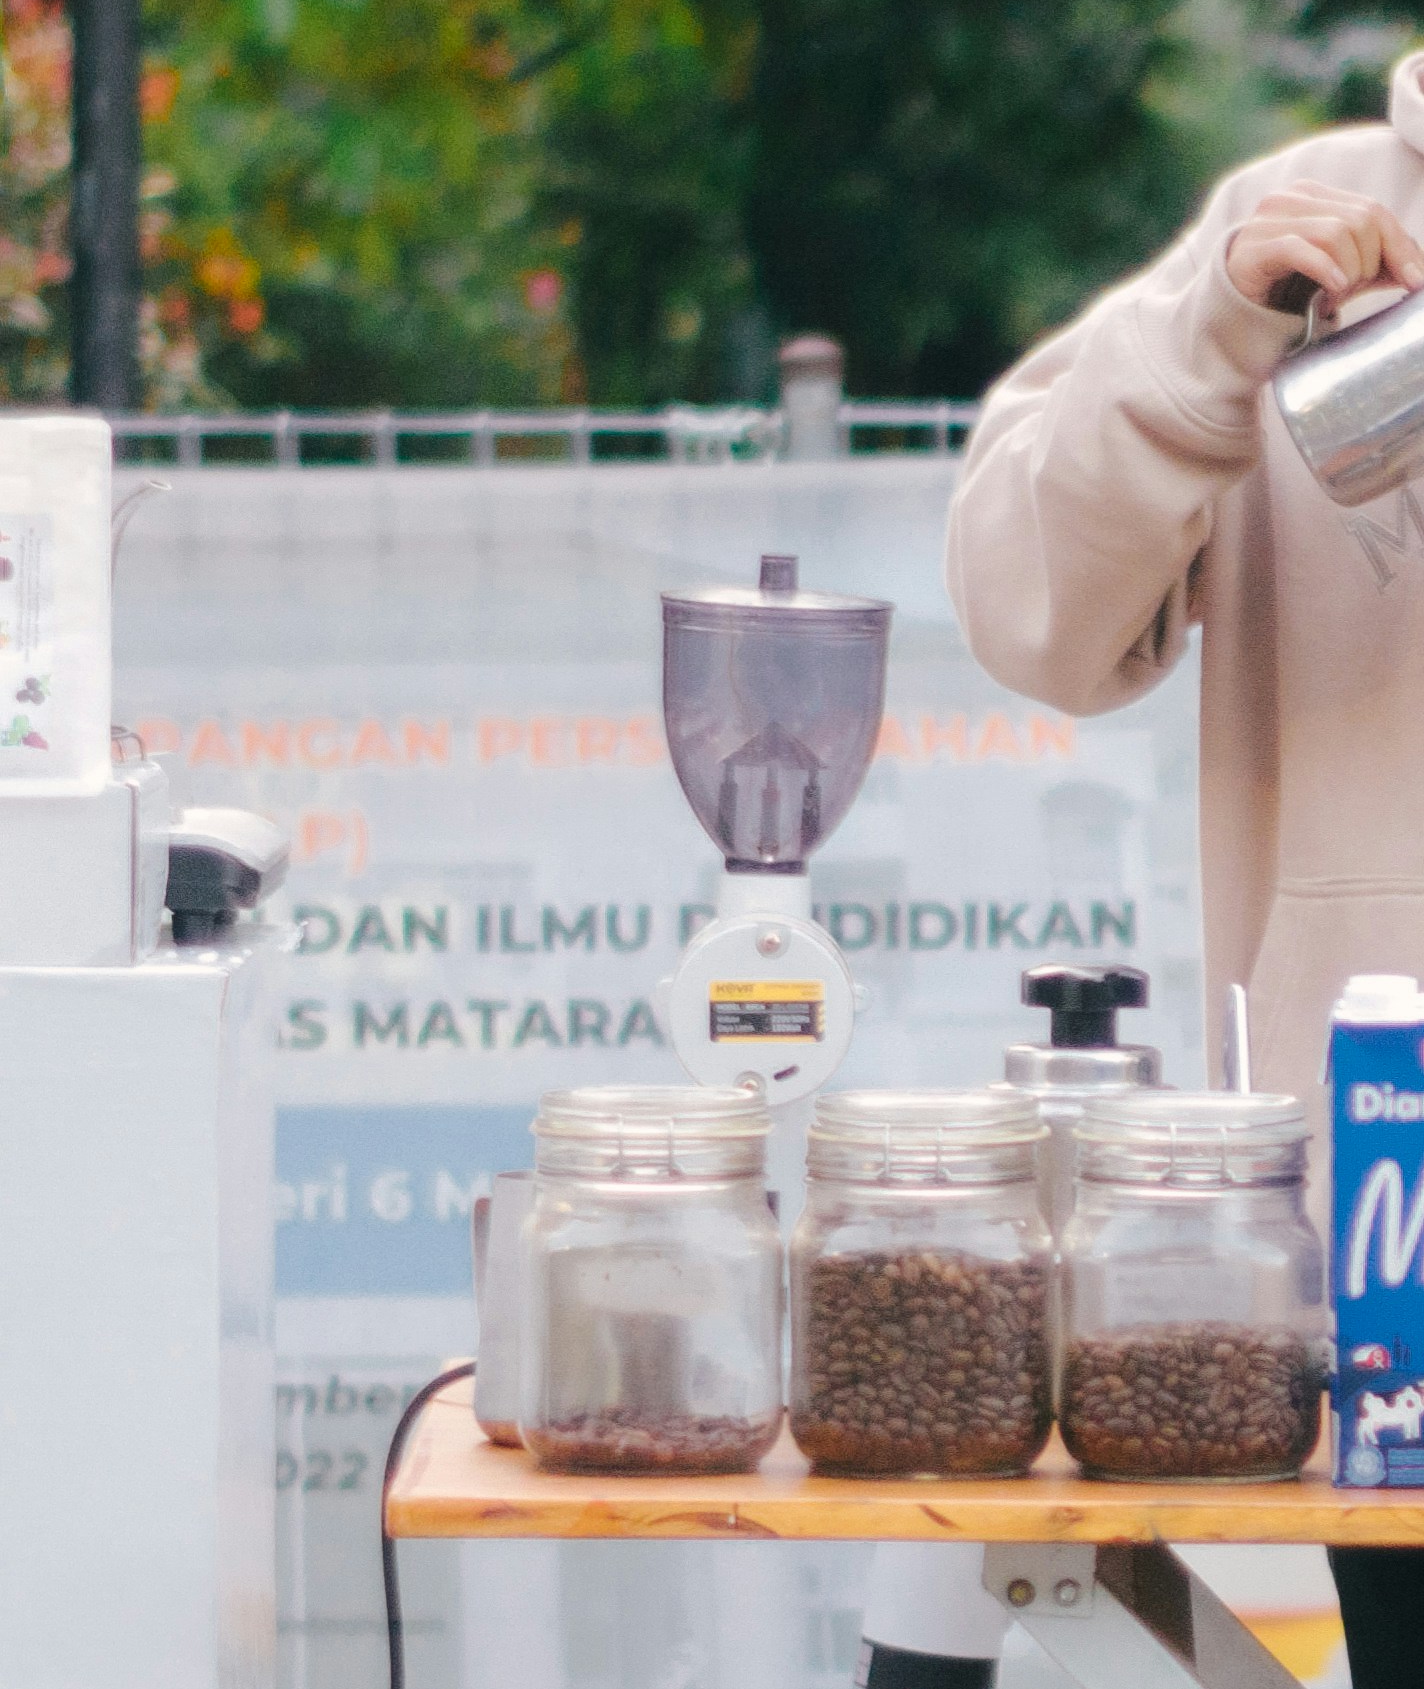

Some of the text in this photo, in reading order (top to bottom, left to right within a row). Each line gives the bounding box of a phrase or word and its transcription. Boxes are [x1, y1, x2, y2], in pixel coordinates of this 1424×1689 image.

[112, 716, 452, 769] PANGAN
[292, 904, 448, 955] DAN
[475, 902, 651, 955] ILMU
[352, 998, 667, 1049] MATARA
[369, 1169, 412, 1223] 6
[276, 1449, 368, 1490] 022
